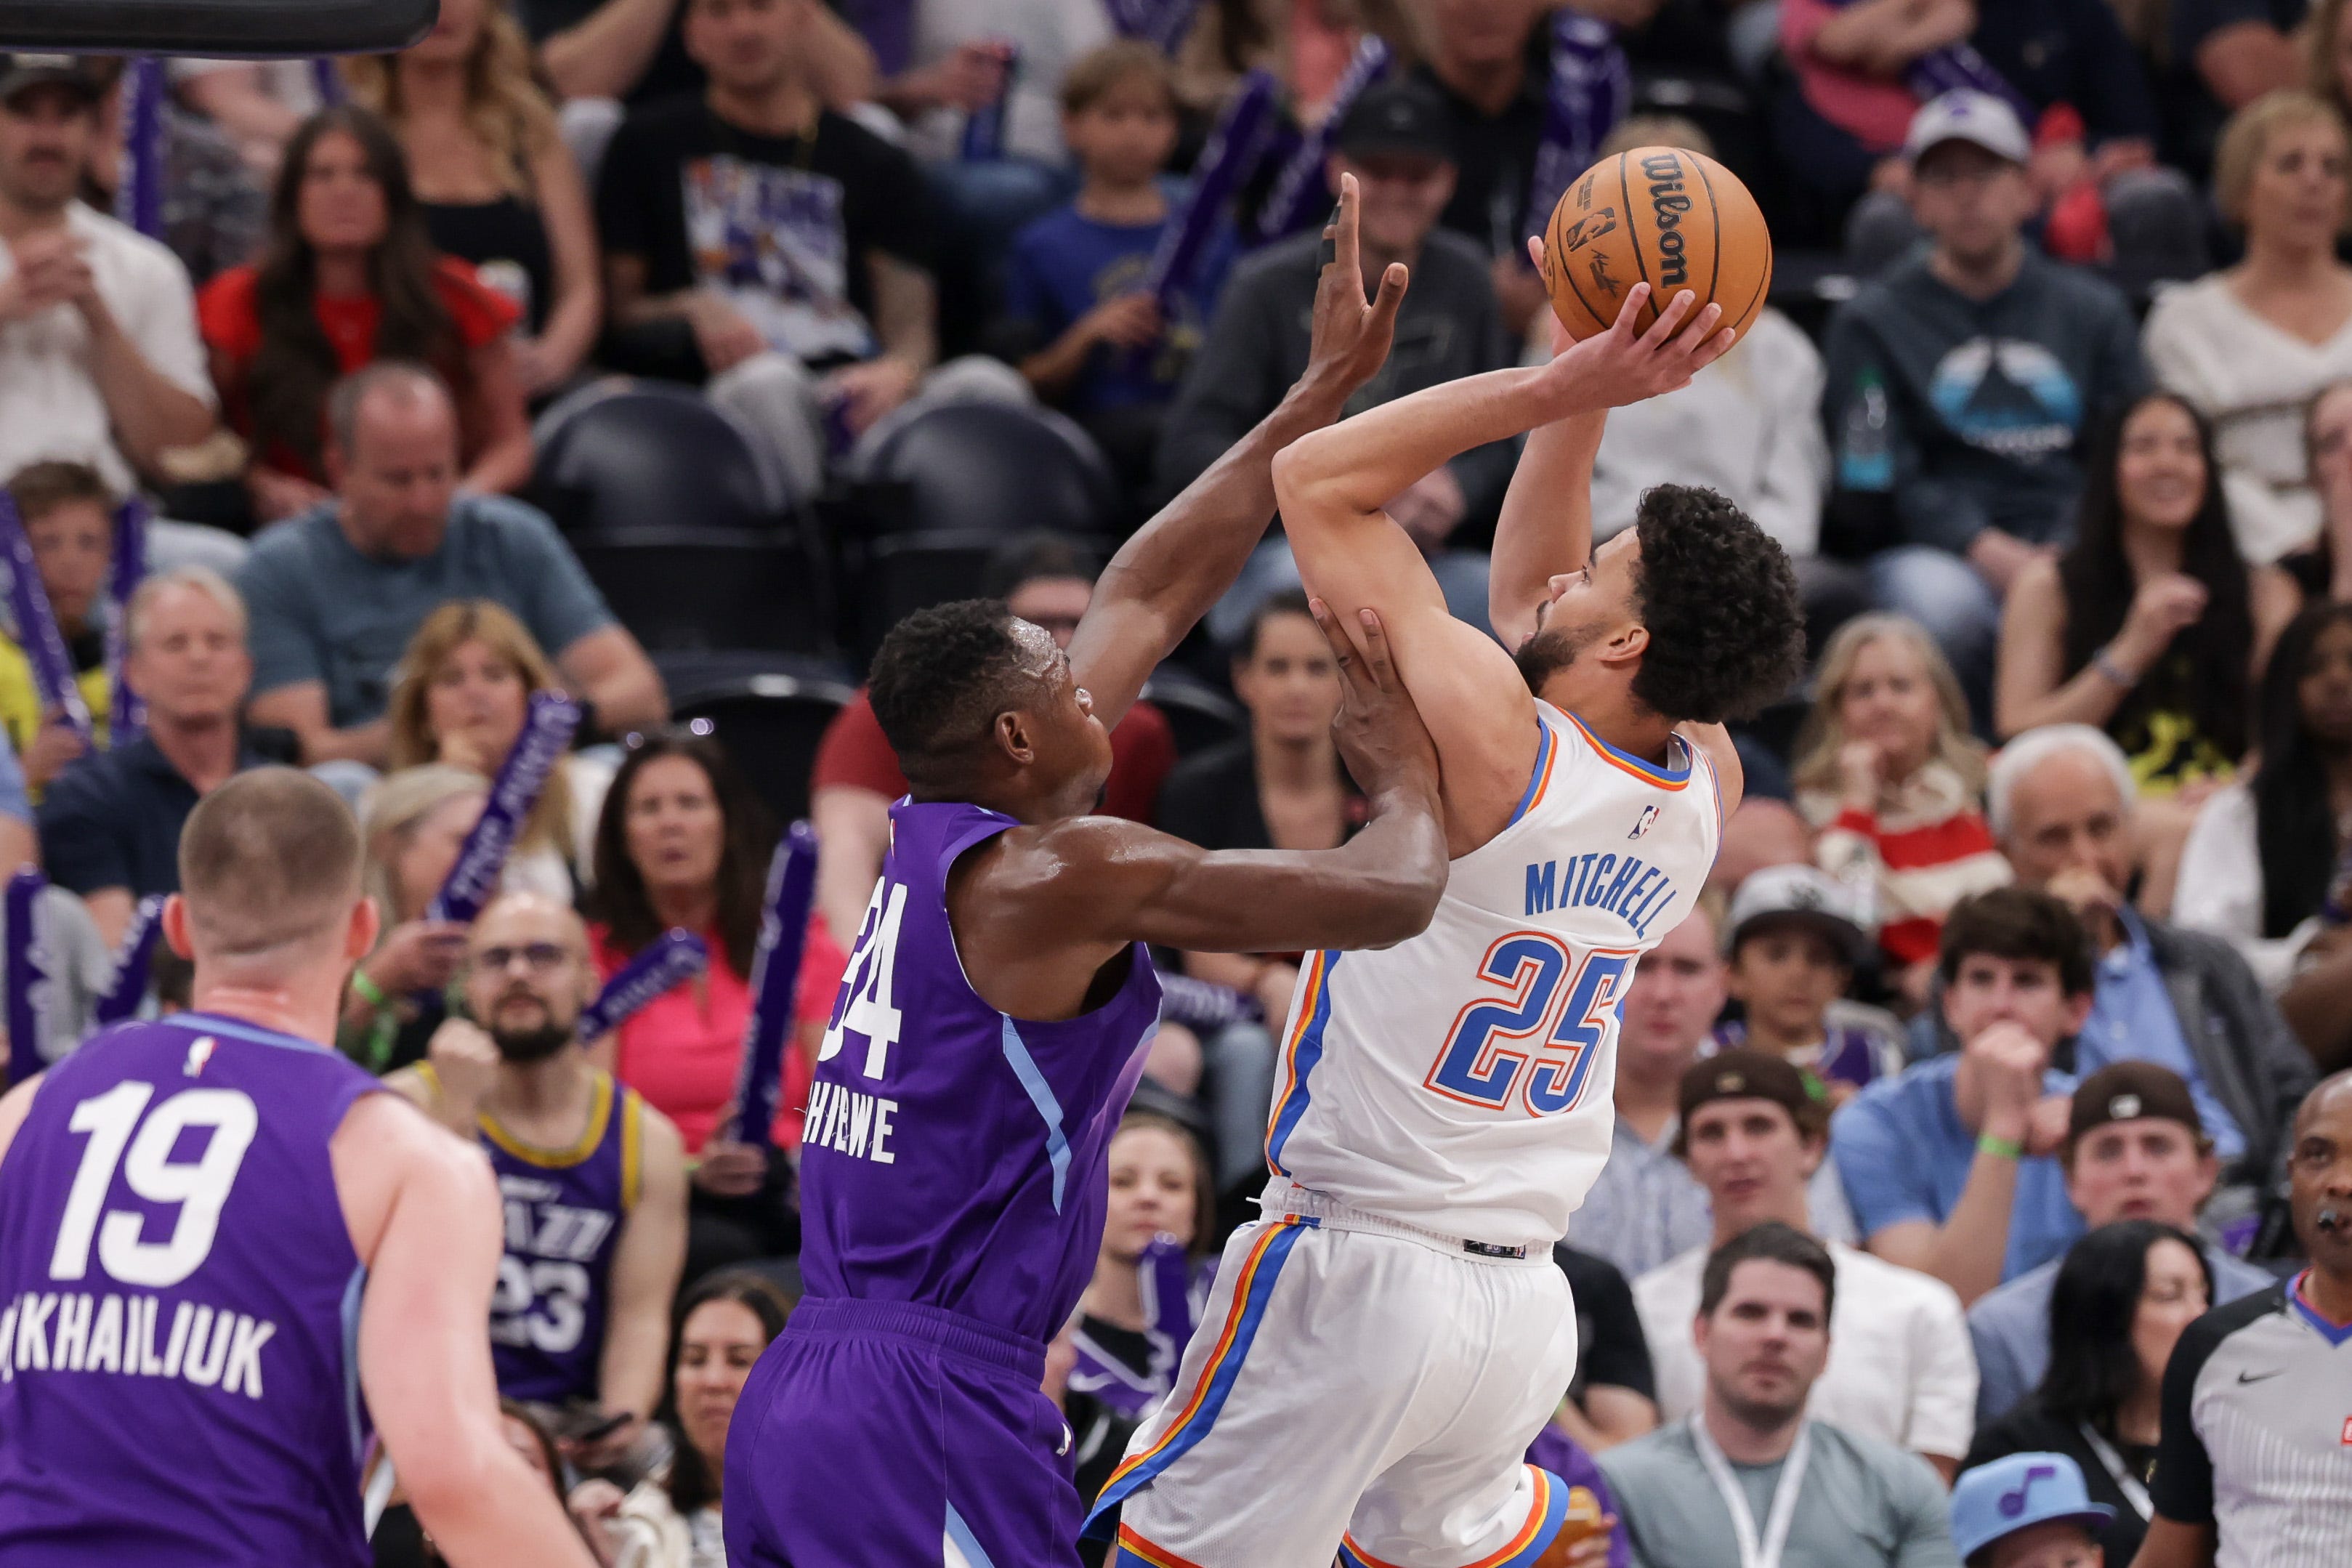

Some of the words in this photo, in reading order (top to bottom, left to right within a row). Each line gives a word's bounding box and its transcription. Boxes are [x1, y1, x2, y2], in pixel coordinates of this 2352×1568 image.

[1640, 153, 1693, 289] Wilson
[1525, 853, 1677, 939] MITCHELL
[817, 876, 908, 1080] 34
[1423, 931, 1641, 1118] 25
[49, 1079, 259, 1290] 19
[503, 1197, 616, 1263] AZZ
[490, 1251, 591, 1353] 23
